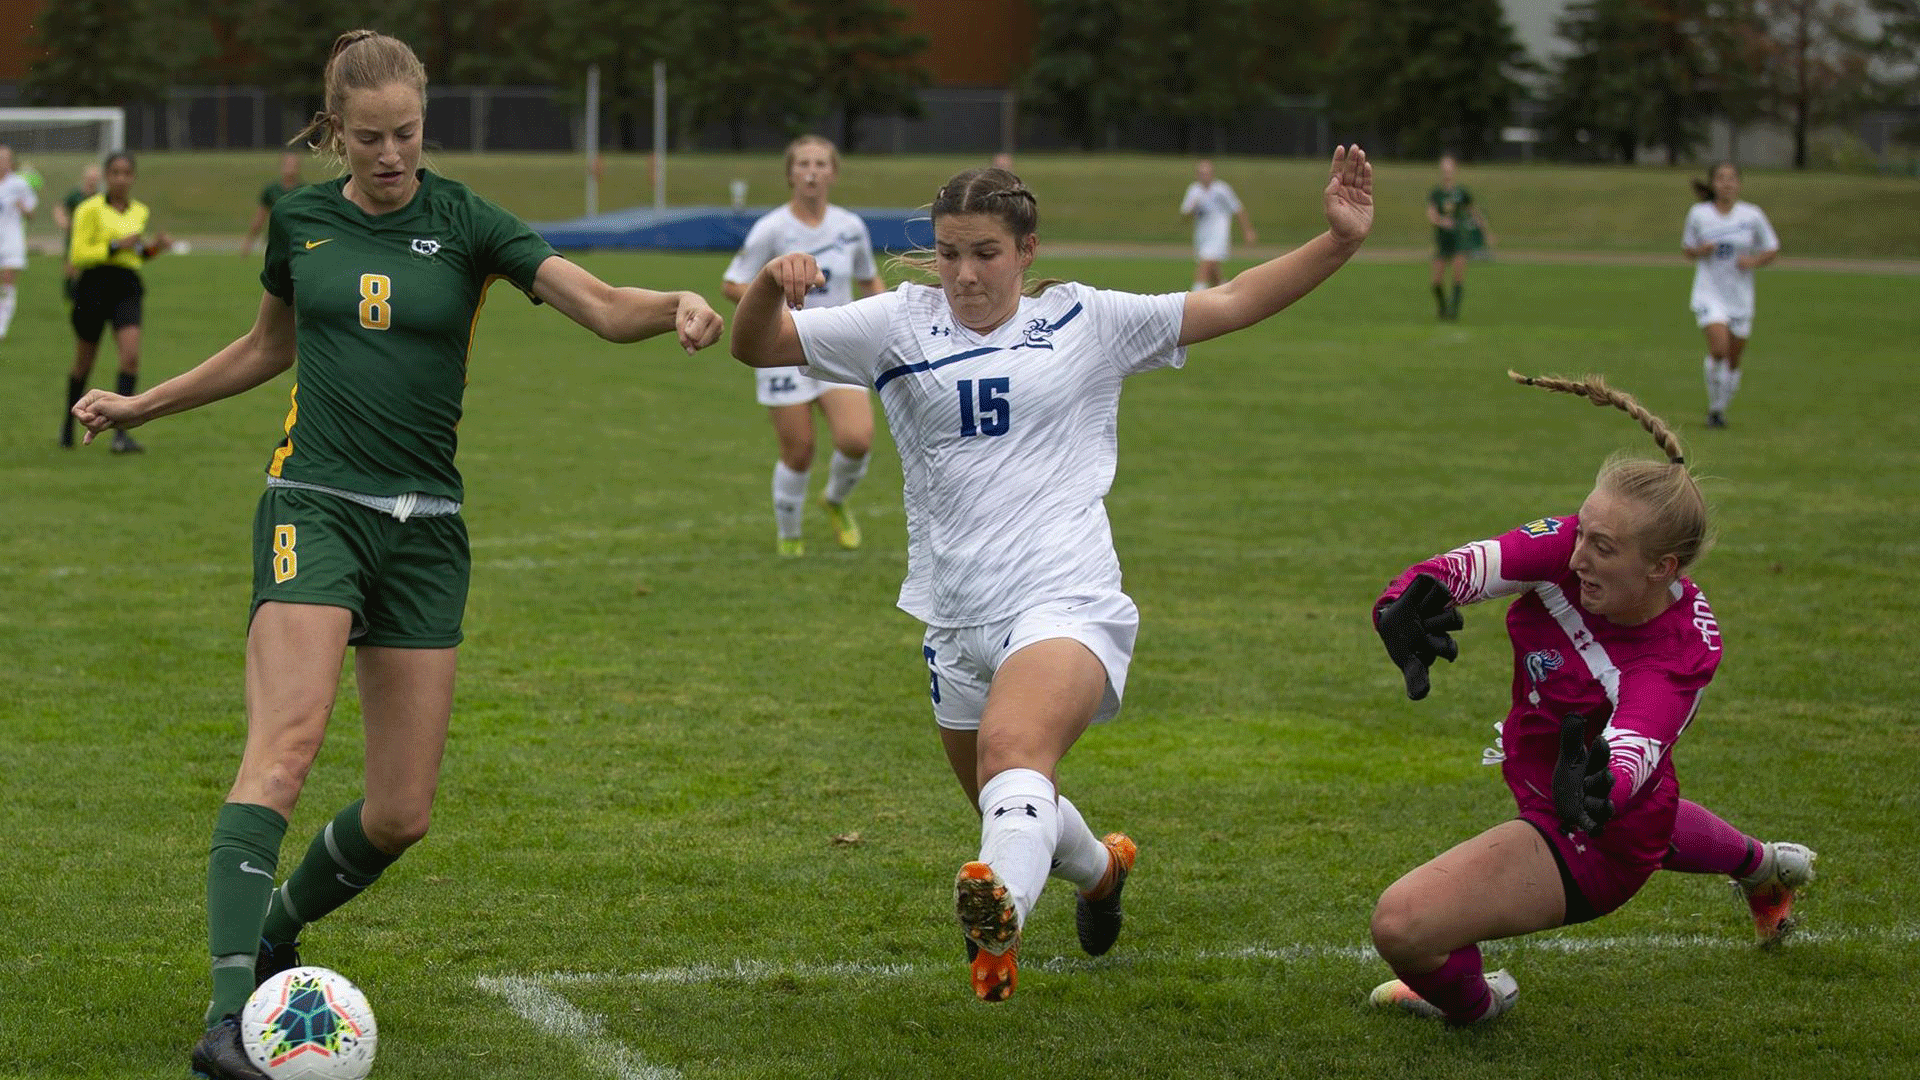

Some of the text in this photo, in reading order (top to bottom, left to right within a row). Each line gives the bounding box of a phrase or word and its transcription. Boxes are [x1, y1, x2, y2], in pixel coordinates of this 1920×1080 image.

[359, 273, 391, 330] 8
[957, 377, 1010, 437] 15
[273, 524, 297, 584] 8
